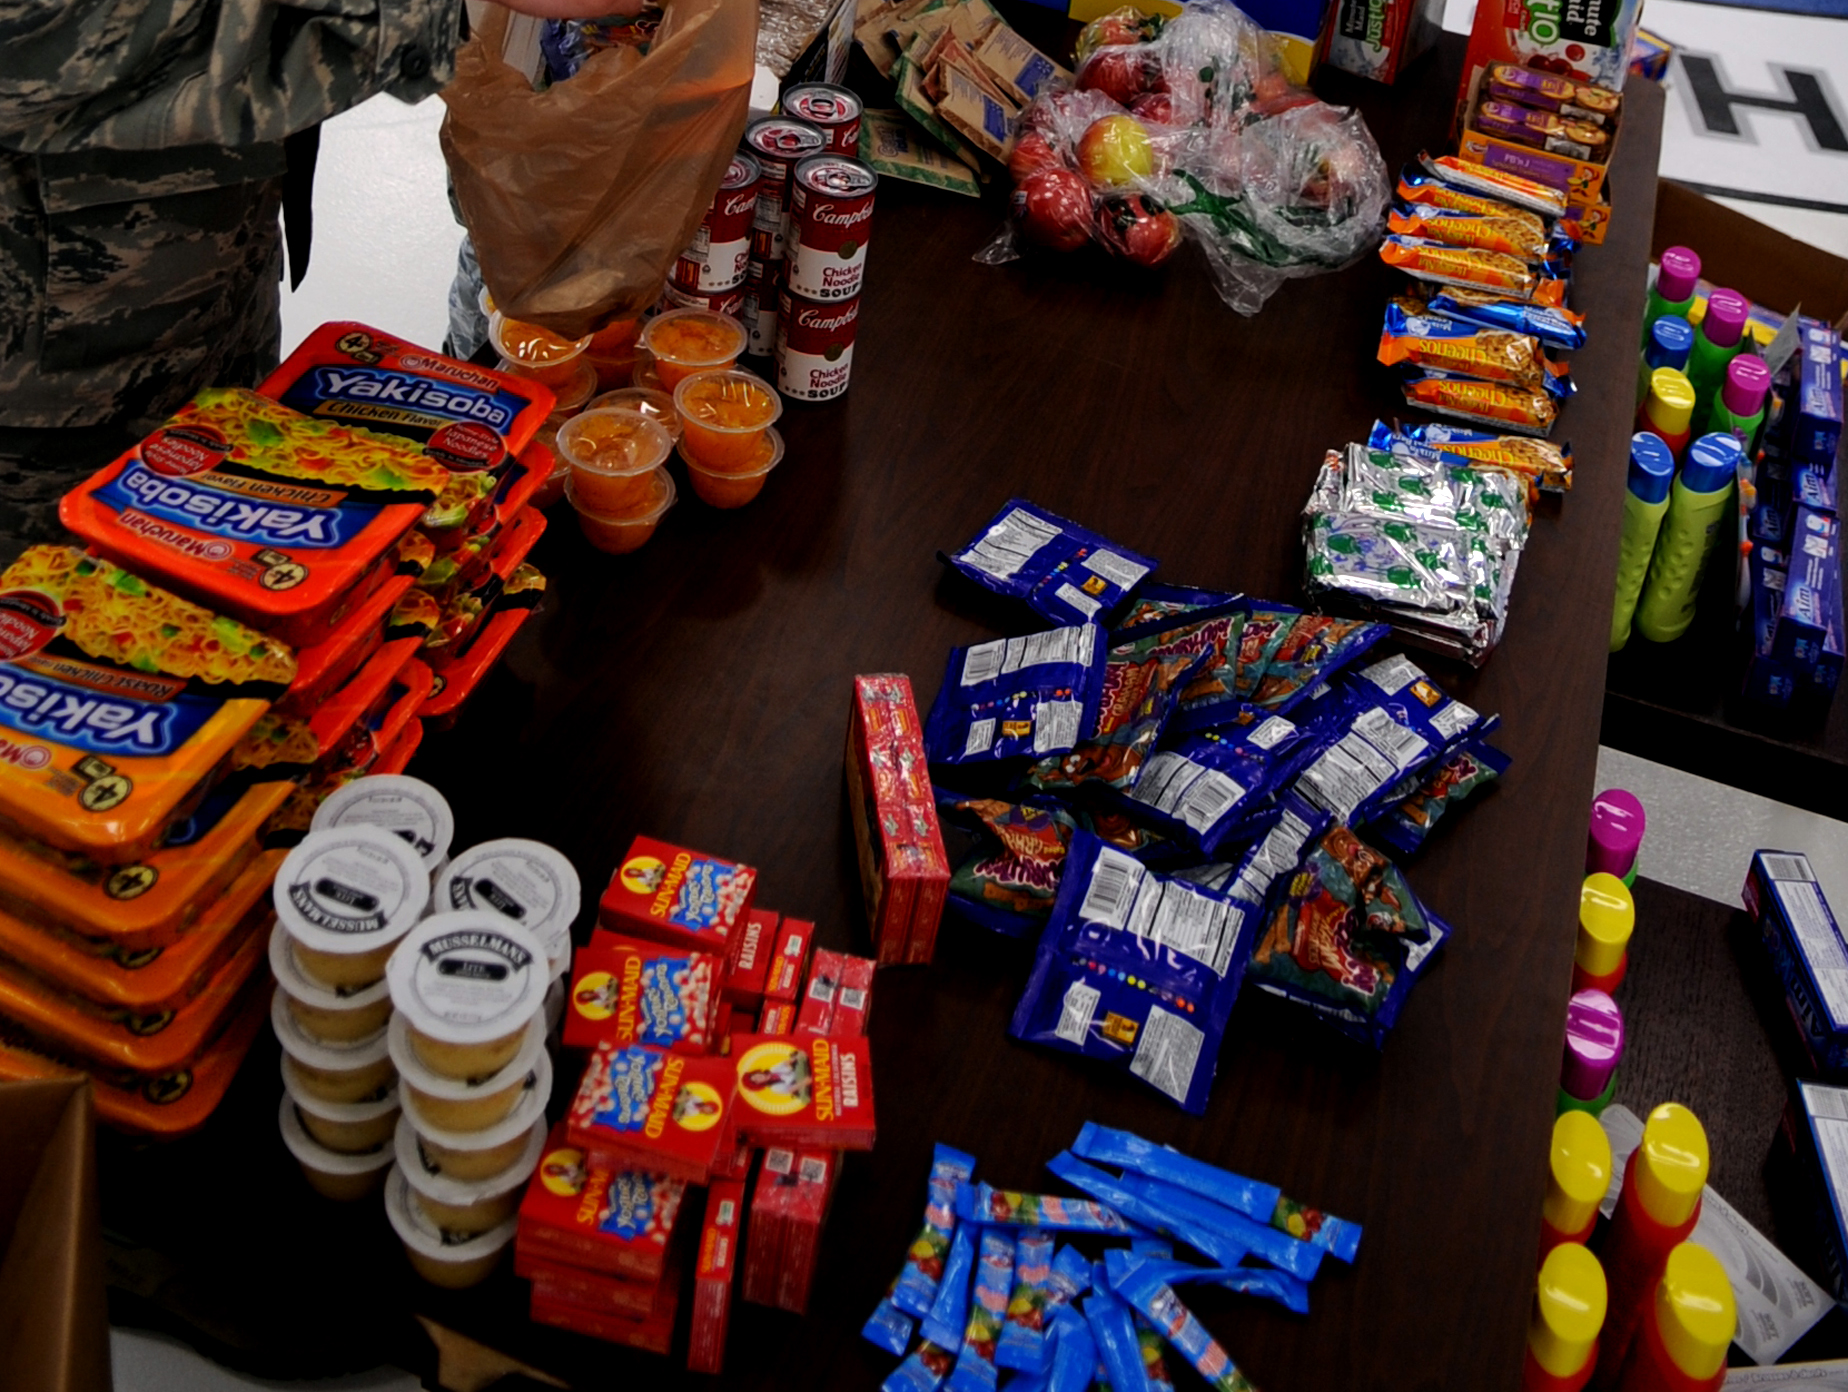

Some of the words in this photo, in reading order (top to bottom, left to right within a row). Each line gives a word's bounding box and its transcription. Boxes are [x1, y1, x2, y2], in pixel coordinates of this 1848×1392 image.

[421, 358, 499, 390] Maruchan
[1418, 339, 1487, 366] Cheerios
[325, 371, 507, 426] Yakisoba
[327, 400, 399, 424] Chicken
[1438, 381, 1507, 407] Cheerios
[125, 470, 326, 541] Yakisoba
[253, 481, 332, 505] Chicken
[119, 511, 206, 558] Maruchan
[0, 674, 160, 745] Yakis
[650, 852, 692, 918] SUN-MAID
[738, 921, 763, 971] RAISINS
[616, 955, 642, 1042] SUN-MAID
[644, 1056, 685, 1139] SUN-MAID
[812, 1038, 835, 1121] SUN-MAID
[839, 1052, 860, 1108] RAISINS
[576, 1169, 610, 1225] SUN-M
